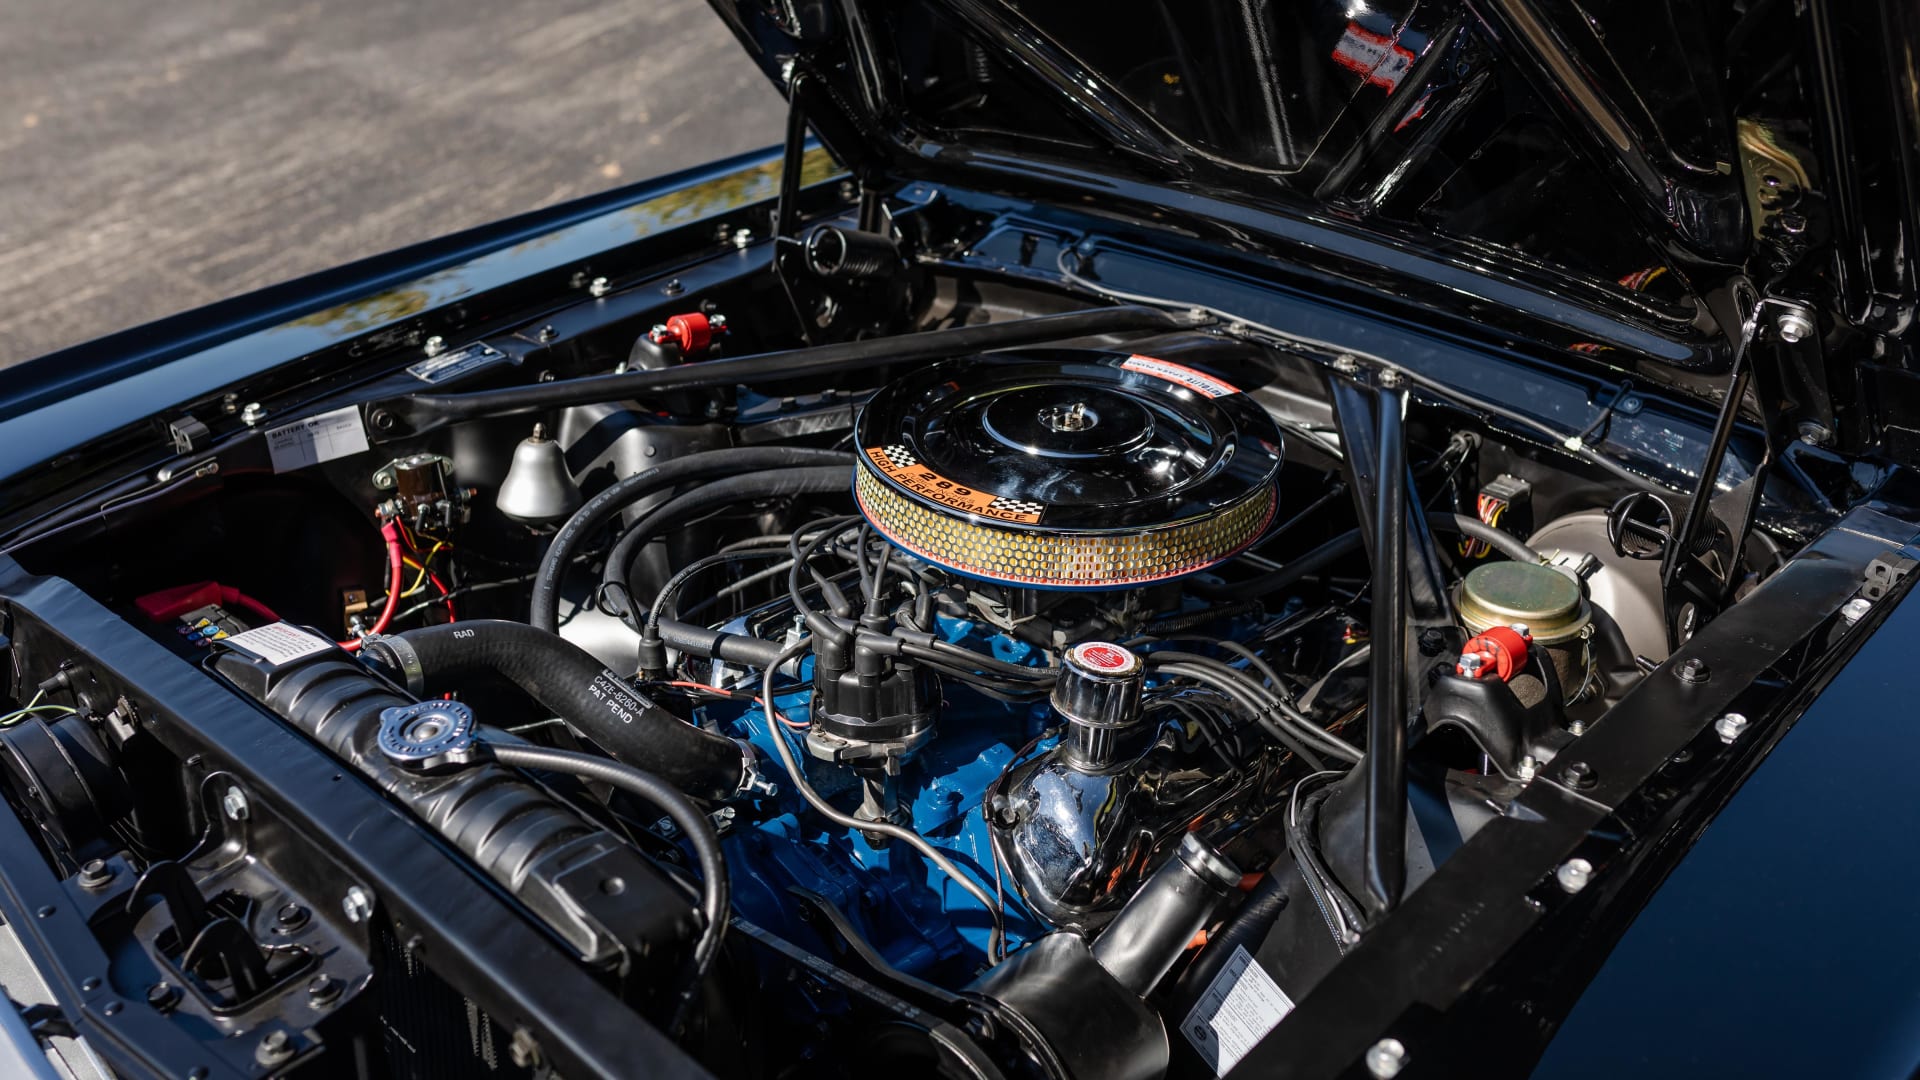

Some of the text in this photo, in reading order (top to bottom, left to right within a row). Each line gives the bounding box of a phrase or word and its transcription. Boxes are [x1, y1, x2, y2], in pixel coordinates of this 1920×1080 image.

[870, 451, 1028, 521] HIGH PERFORMANCE
[453, 629, 475, 639] RAD
[588, 684, 606, 701] PAT
[606, 699, 633, 724] PEND
[594, 675, 645, 717] C4ZE-8260-A
